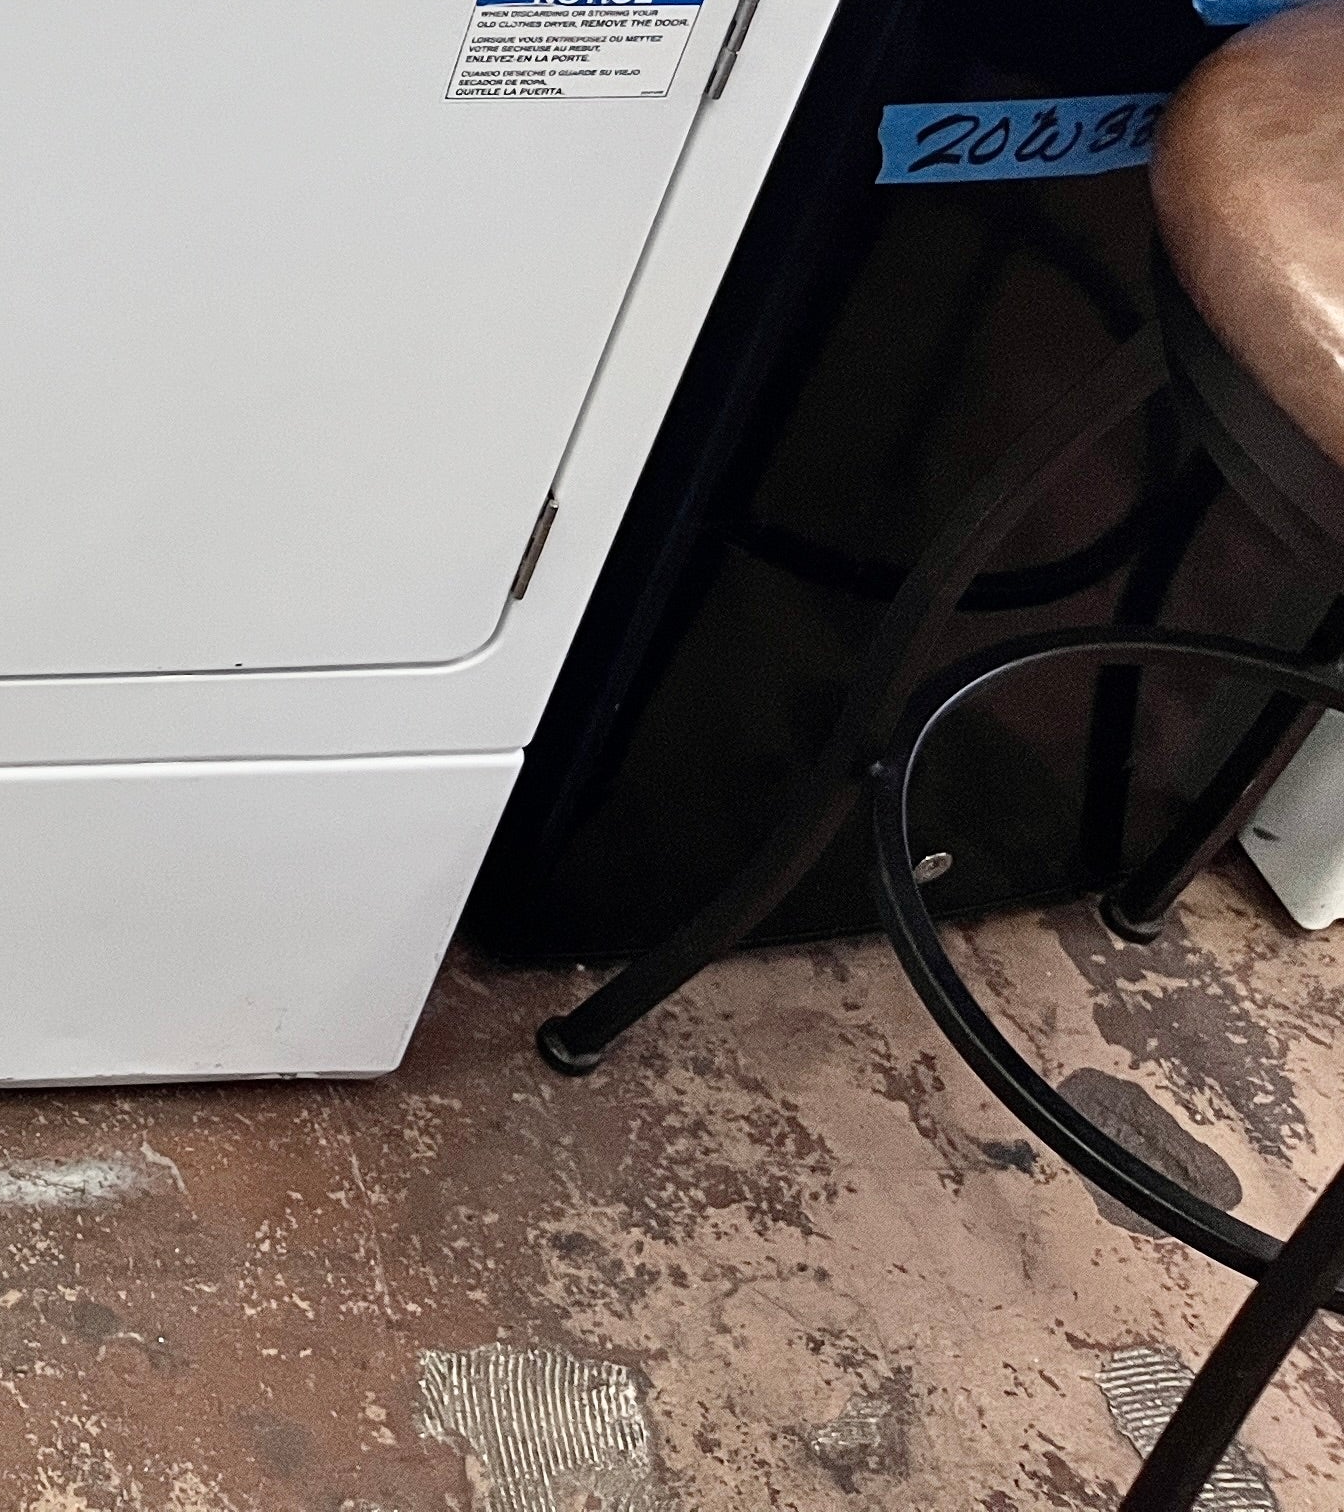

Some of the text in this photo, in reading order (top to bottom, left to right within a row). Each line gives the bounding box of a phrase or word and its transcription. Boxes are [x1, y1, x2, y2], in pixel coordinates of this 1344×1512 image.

[581, 19, 628, 27] REMOVE
[631, 19, 652, 27] THE
[654, 19, 689, 27] DOOR.
[455, 88, 501, 96] QUITELE
